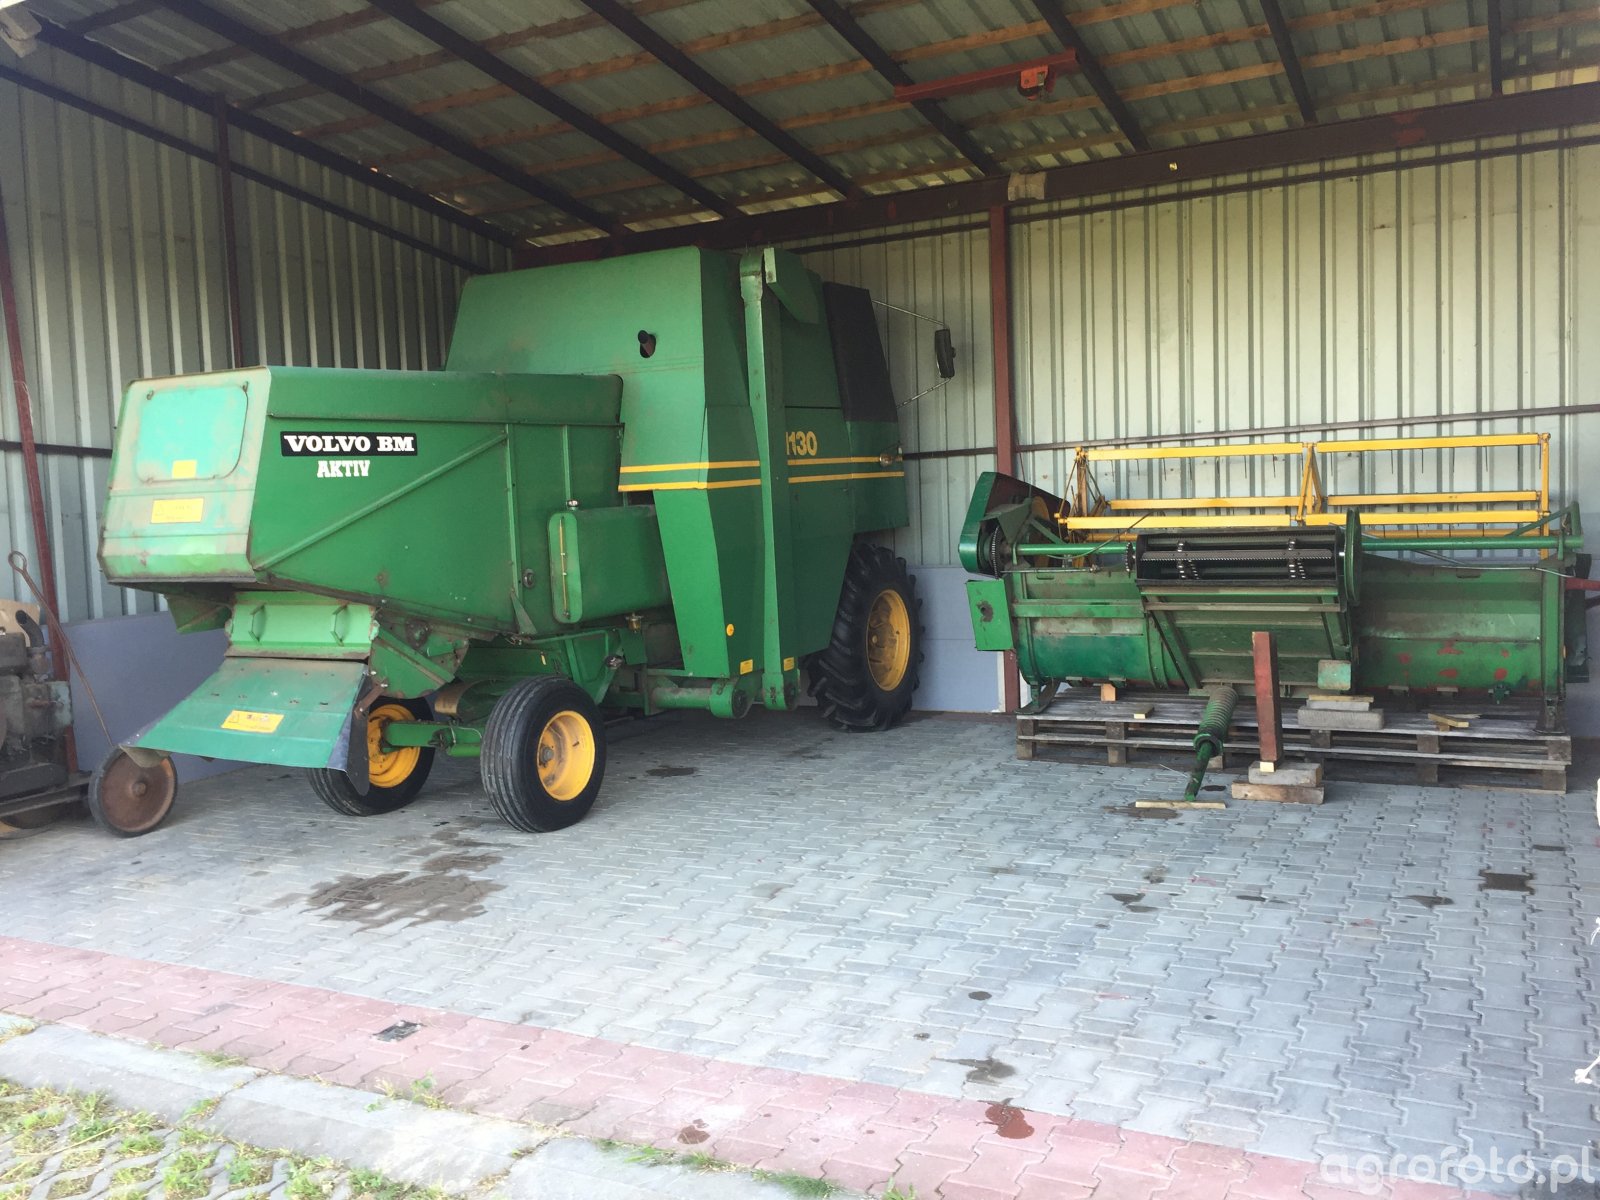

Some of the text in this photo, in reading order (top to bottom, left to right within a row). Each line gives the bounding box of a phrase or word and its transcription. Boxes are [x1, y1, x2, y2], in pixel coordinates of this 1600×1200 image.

[283, 434, 415, 452] VOLVO BM
[317, 460, 371, 478] AKTIV
